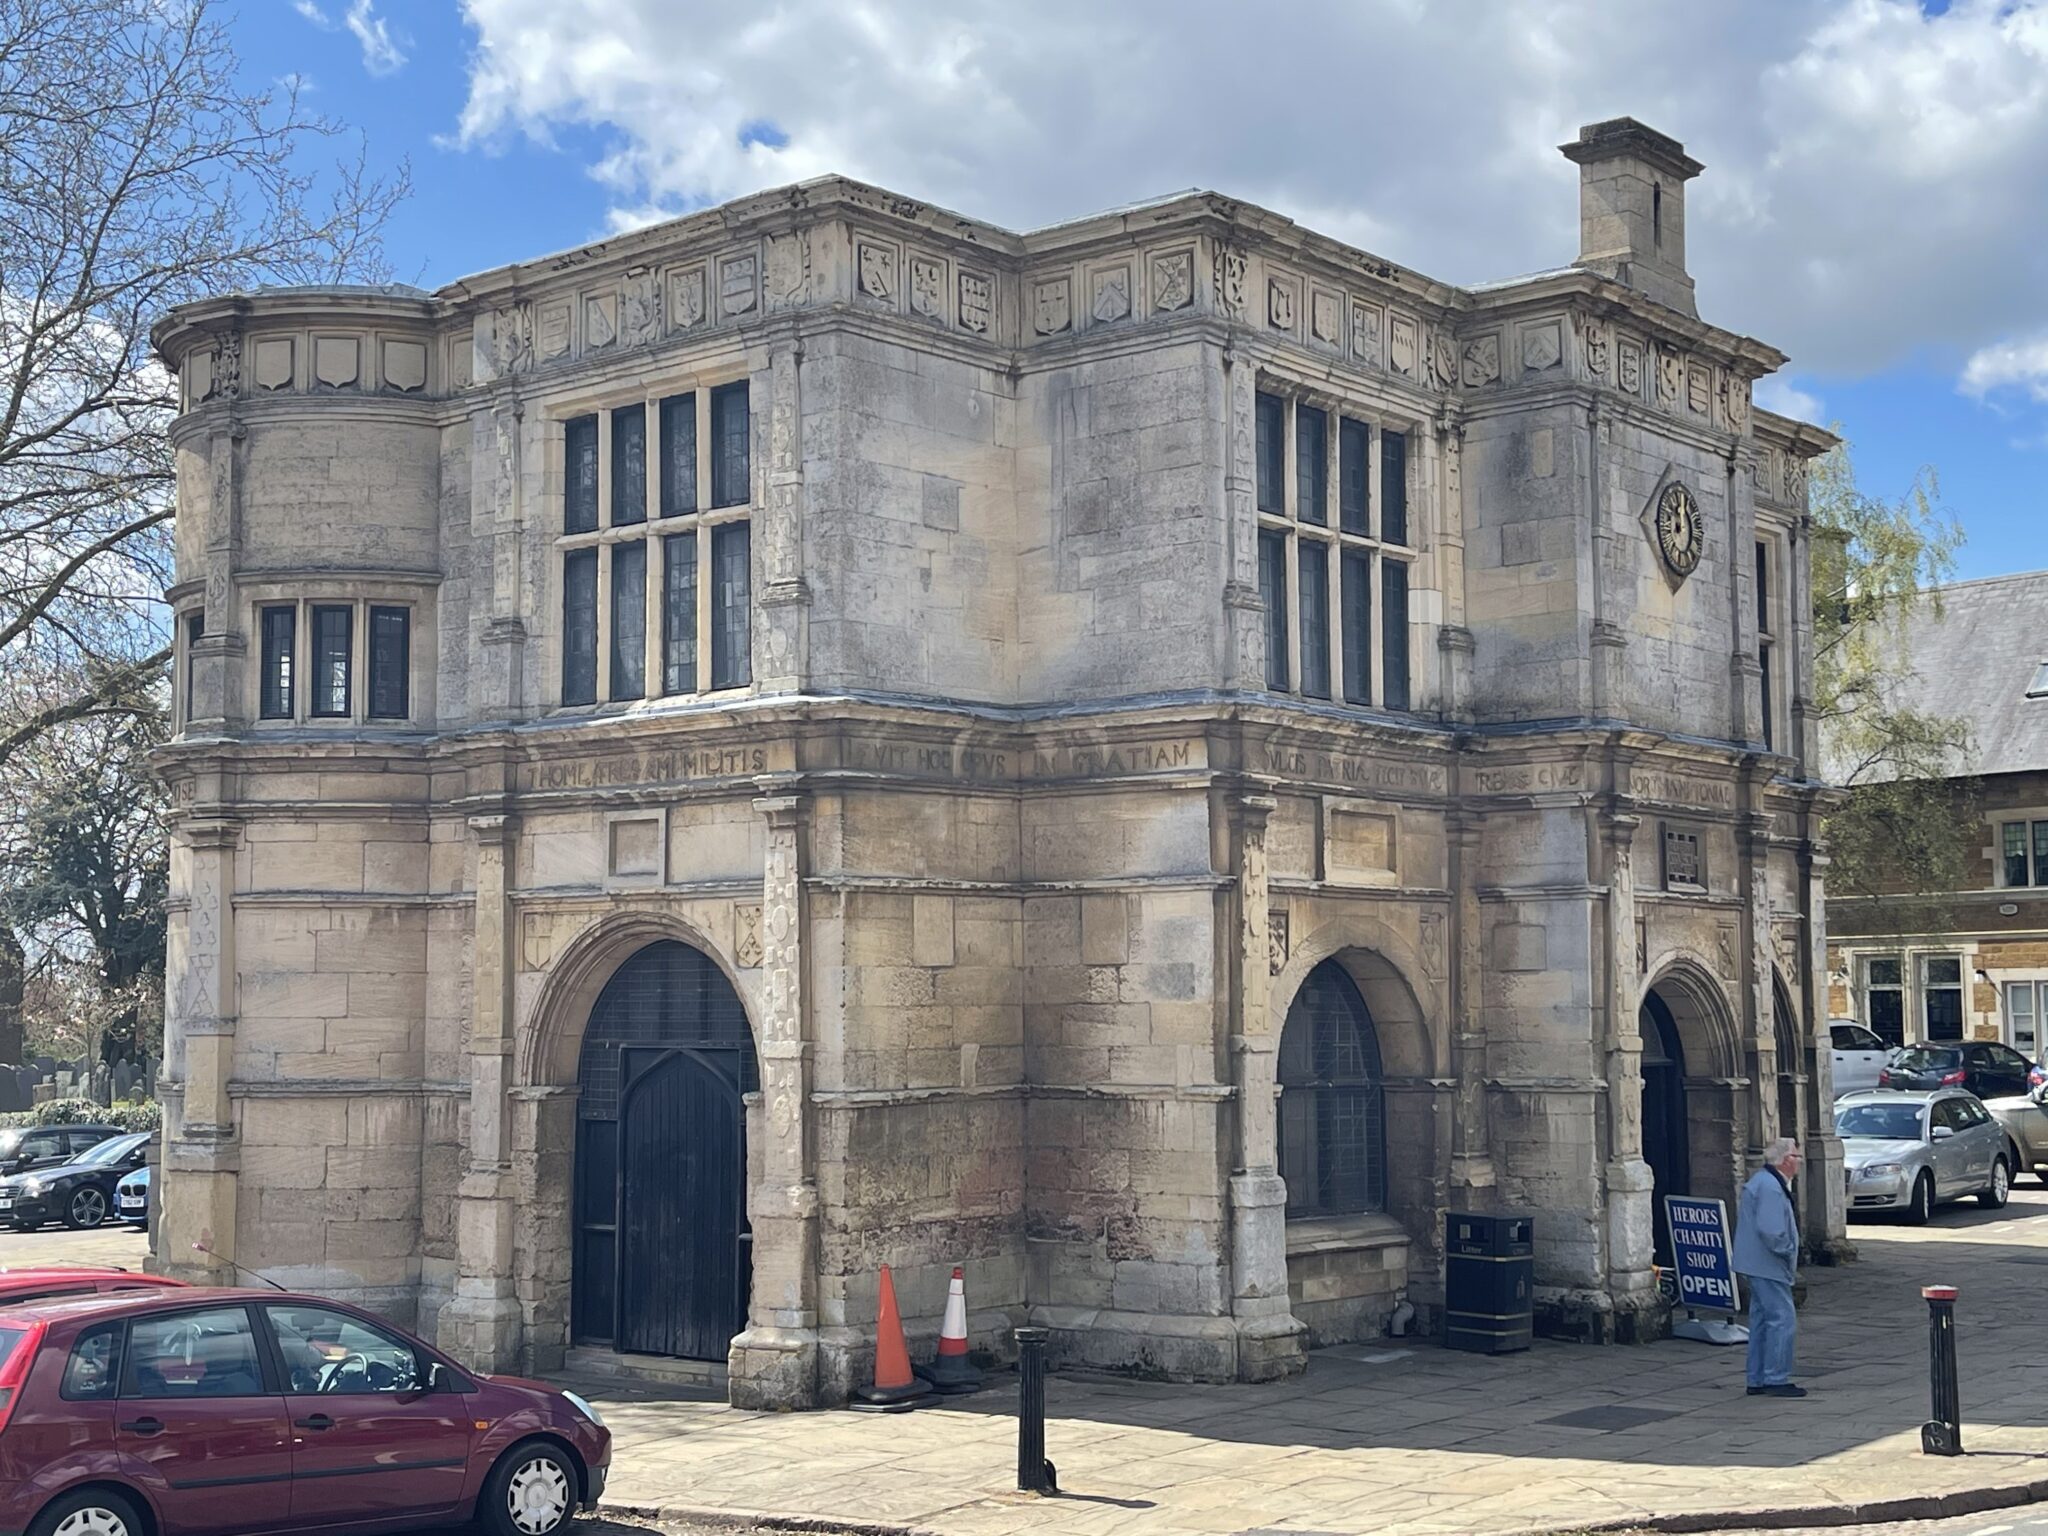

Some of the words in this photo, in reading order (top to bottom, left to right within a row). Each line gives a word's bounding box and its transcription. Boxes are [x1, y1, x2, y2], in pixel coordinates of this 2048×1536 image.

[1672, 1206, 1719, 1226] HEROES
[1674, 1228, 1723, 1249] CHARITY
[1686, 1251, 1717, 1270] SHOP
[1682, 1274, 1732, 1298] OPEN
